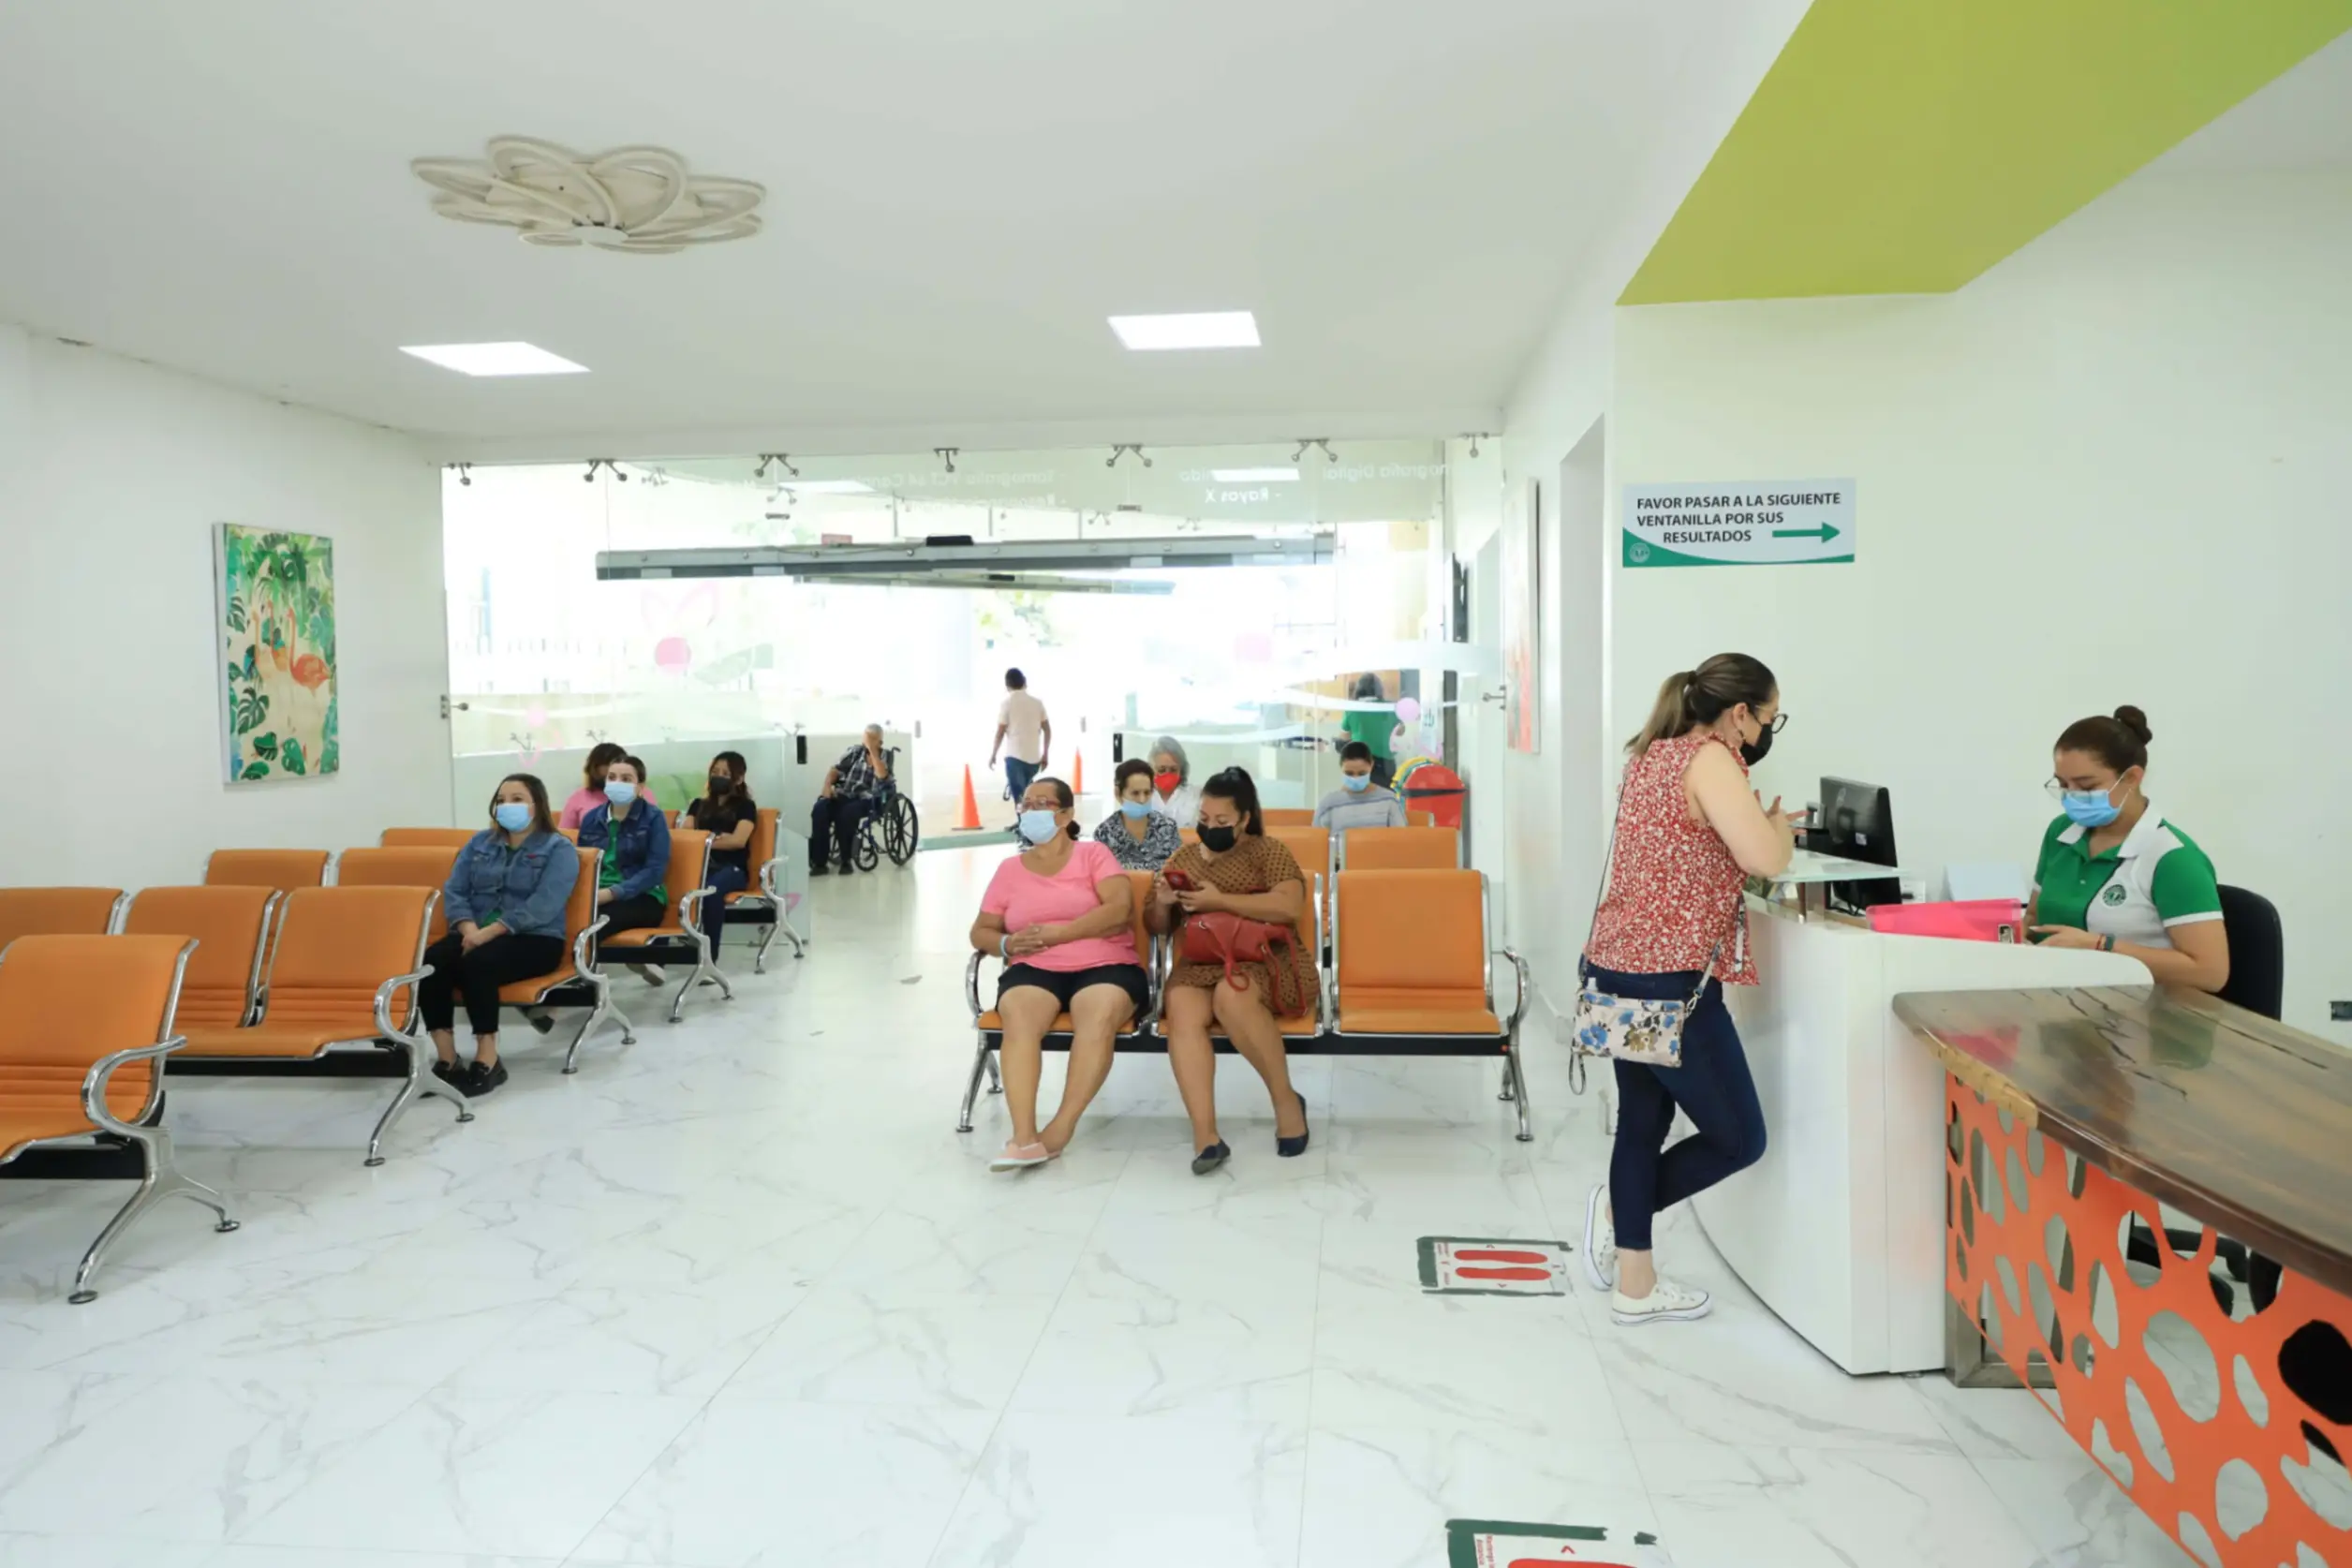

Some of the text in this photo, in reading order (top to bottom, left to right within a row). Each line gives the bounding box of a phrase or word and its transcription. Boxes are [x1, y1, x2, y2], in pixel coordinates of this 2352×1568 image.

[1636, 493, 1841, 510] FAVOR PASAR A LA SIGUIENTE
[1636, 511, 1784, 527] VENTANILLA POR SUS
[1663, 530, 1752, 543] RESULTADOS
